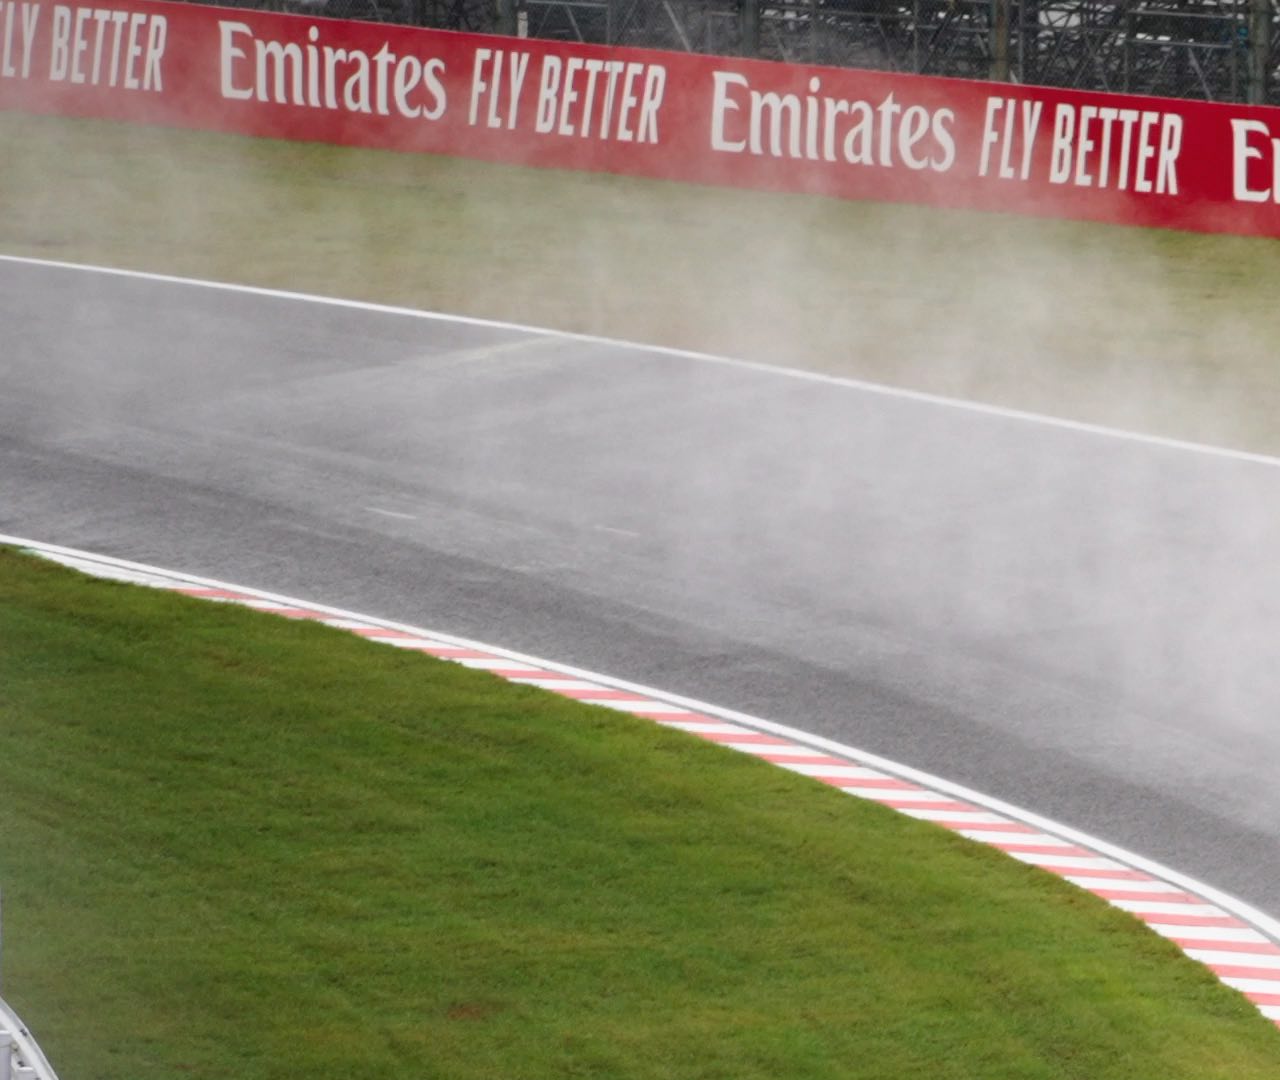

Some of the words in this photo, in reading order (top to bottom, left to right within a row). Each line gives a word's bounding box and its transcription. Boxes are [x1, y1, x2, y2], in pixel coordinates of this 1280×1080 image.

[0, 1, 40, 79] LY
[49, 5, 167, 92] BETTER
[218, 20, 447, 123] Emirates
[468, 48, 530, 130] FLY
[535, 55, 667, 145] BETTER
[710, 71, 957, 173] Emirates
[978, 96, 1042, 181] FLY
[1049, 104, 1183, 196] BETTER
